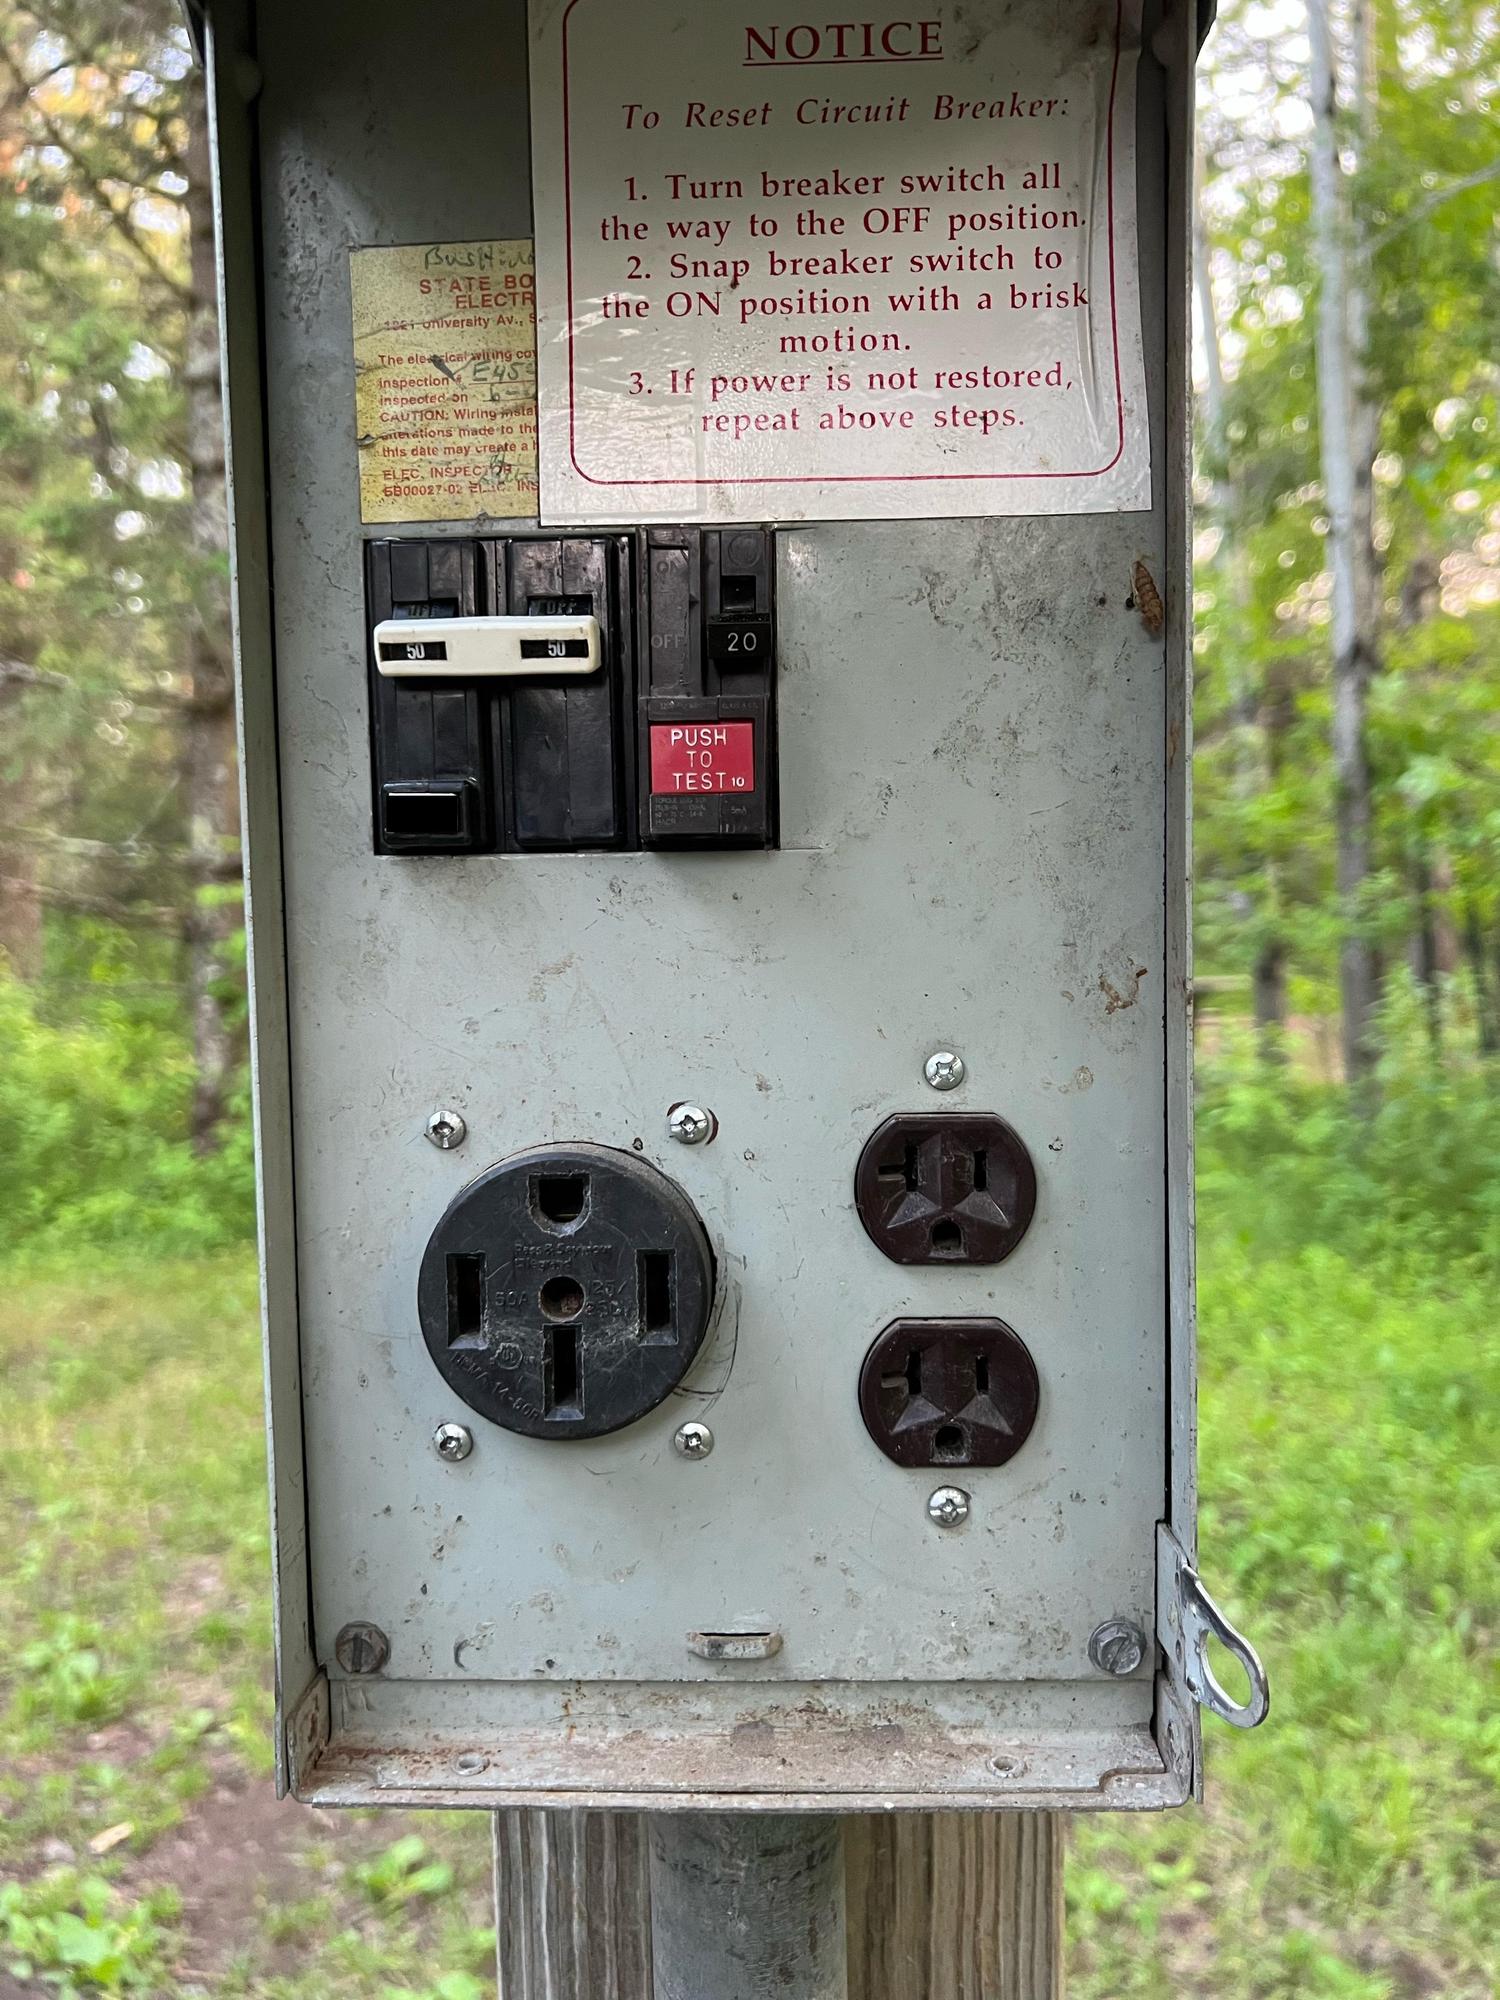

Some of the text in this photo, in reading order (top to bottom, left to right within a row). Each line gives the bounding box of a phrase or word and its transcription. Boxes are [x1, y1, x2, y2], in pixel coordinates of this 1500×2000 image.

[745, 21, 943, 61] NOTICE
[621, 92, 1070, 130] To Reset Circuit Breaker:
[624, 162, 1061, 201] 1. Turn breaker switch all
[600, 203, 1086, 247] the way to the OFF position.
[627, 244, 1063, 286] 2. Snap breaker switch to
[419, 276, 491, 295] STATE
[602, 282, 1089, 324] the ON position with a brisk
[422, 316, 490, 332] University
[779, 326, 911, 353] motion.
[378, 354, 404, 366] The
[379, 374, 449, 390] inspection
[628, 361, 1072, 402] 3. If power is not restored,
[454, 408, 497, 422] Wiring
[702, 404, 1024, 439] repeat above steps.
[458, 424, 494, 438] made
[501, 423, 513, 435] to
[382, 445, 407, 458] this
[411, 444, 439, 457] date
[443, 443, 471, 458] may
[475, 441, 516, 454] create
[520, 442, 529, 452] a
[547, 640, 566, 657] 50
[651, 633, 685, 649] OFF
[727, 632, 757, 652] 20
[406, 643, 425, 660] 50
[670, 728, 727, 747] PUSH
[685, 749, 713, 769] TO
[672, 771, 727, 791] TEST
[731, 776, 745, 788] 10
